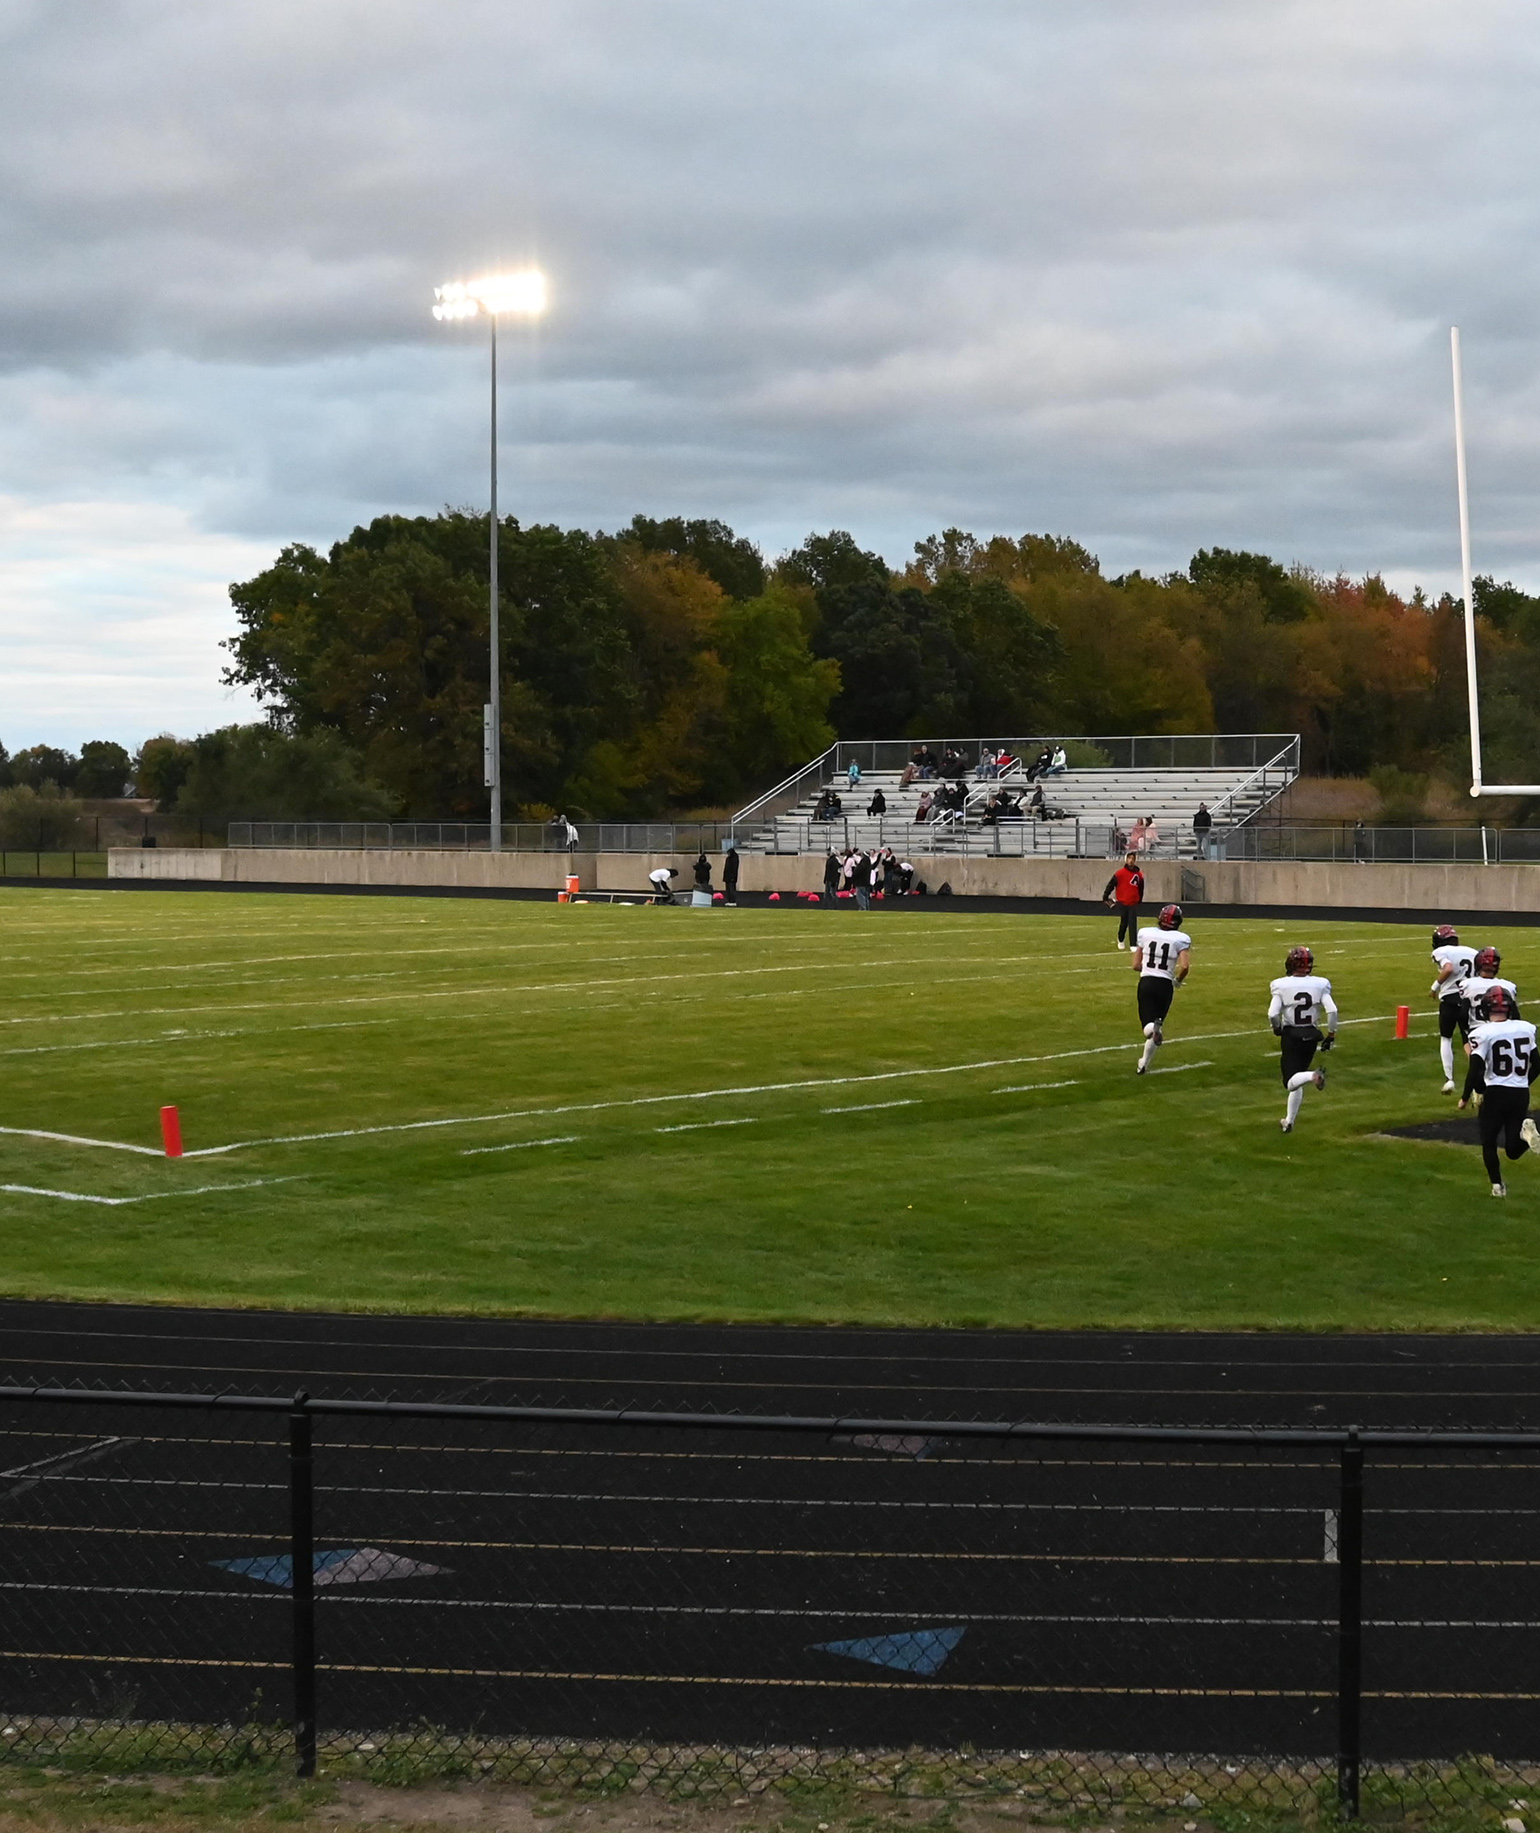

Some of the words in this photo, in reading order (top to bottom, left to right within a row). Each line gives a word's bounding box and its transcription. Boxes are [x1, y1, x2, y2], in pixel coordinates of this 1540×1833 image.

[1146, 941, 1171, 970] 11
[1294, 992, 1313, 1025] 2
[1492, 1037, 1530, 1077] 65
